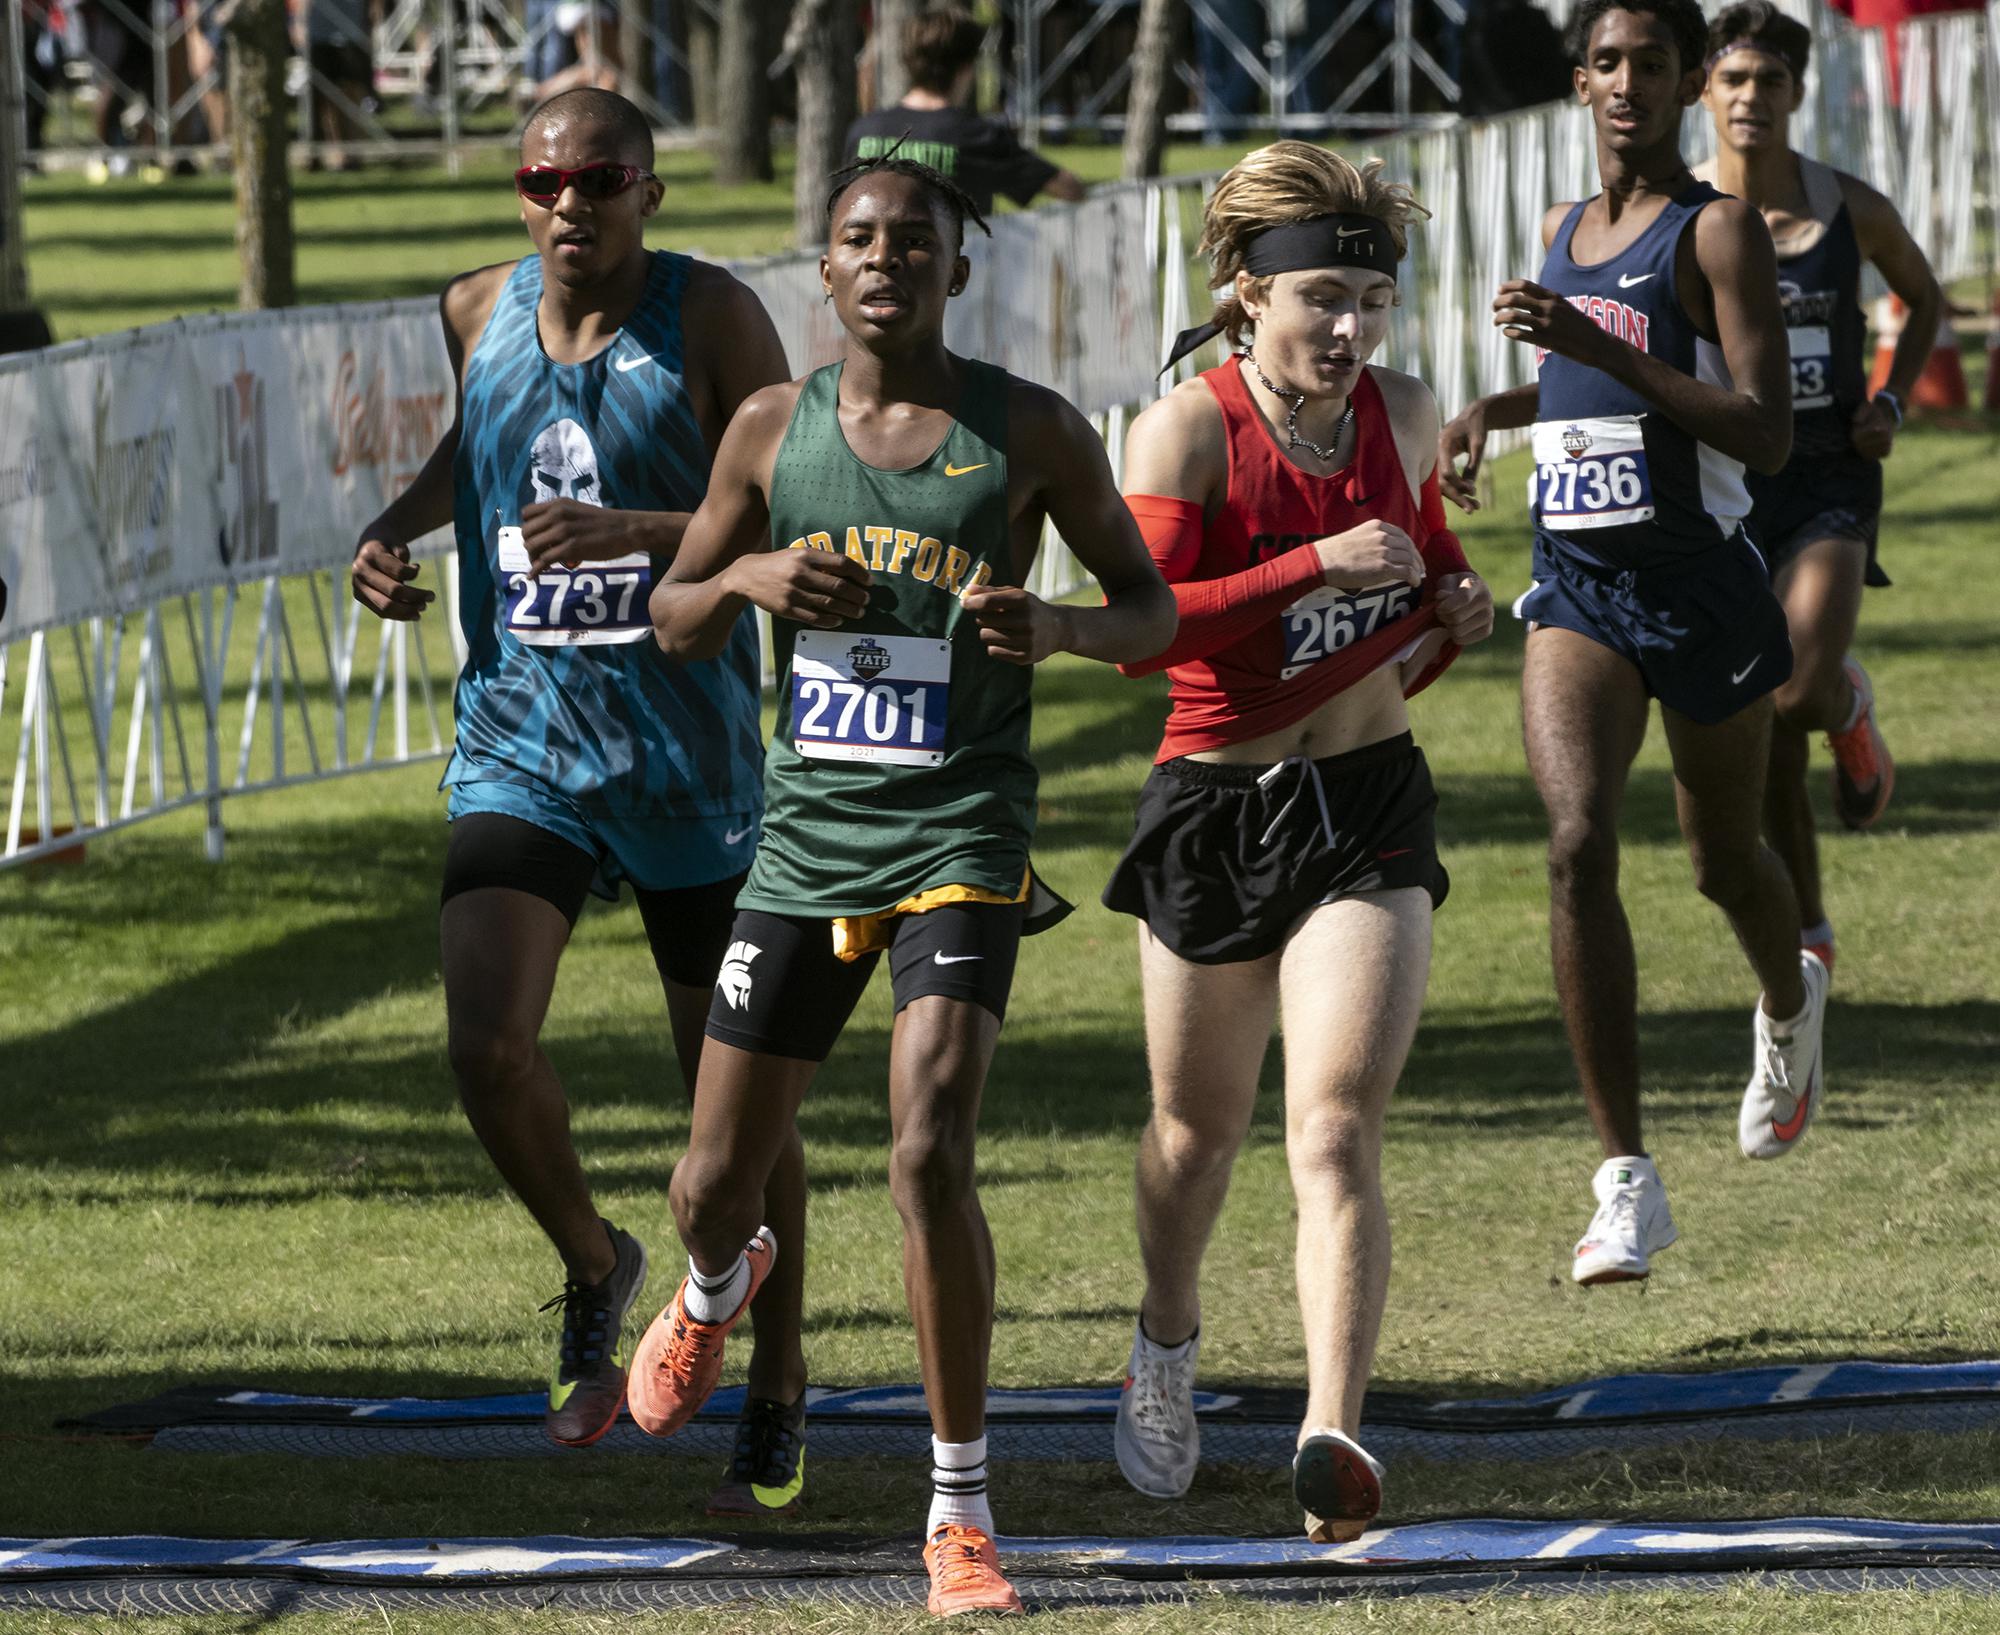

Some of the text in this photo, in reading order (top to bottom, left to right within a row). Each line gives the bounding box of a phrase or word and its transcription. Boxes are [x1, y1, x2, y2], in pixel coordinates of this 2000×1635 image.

[1338, 240, 1374, 256] FLY
[1535, 295, 1648, 369] SON
[1541, 457, 1641, 509] 2736
[789, 526, 992, 599] ATFORD
[509, 573, 639, 625] 2737
[1291, 586, 1411, 662] 2675
[847, 653, 890, 667] STATE
[800, 680, 926, 743] 2701
[851, 747, 874, 756] 2021
